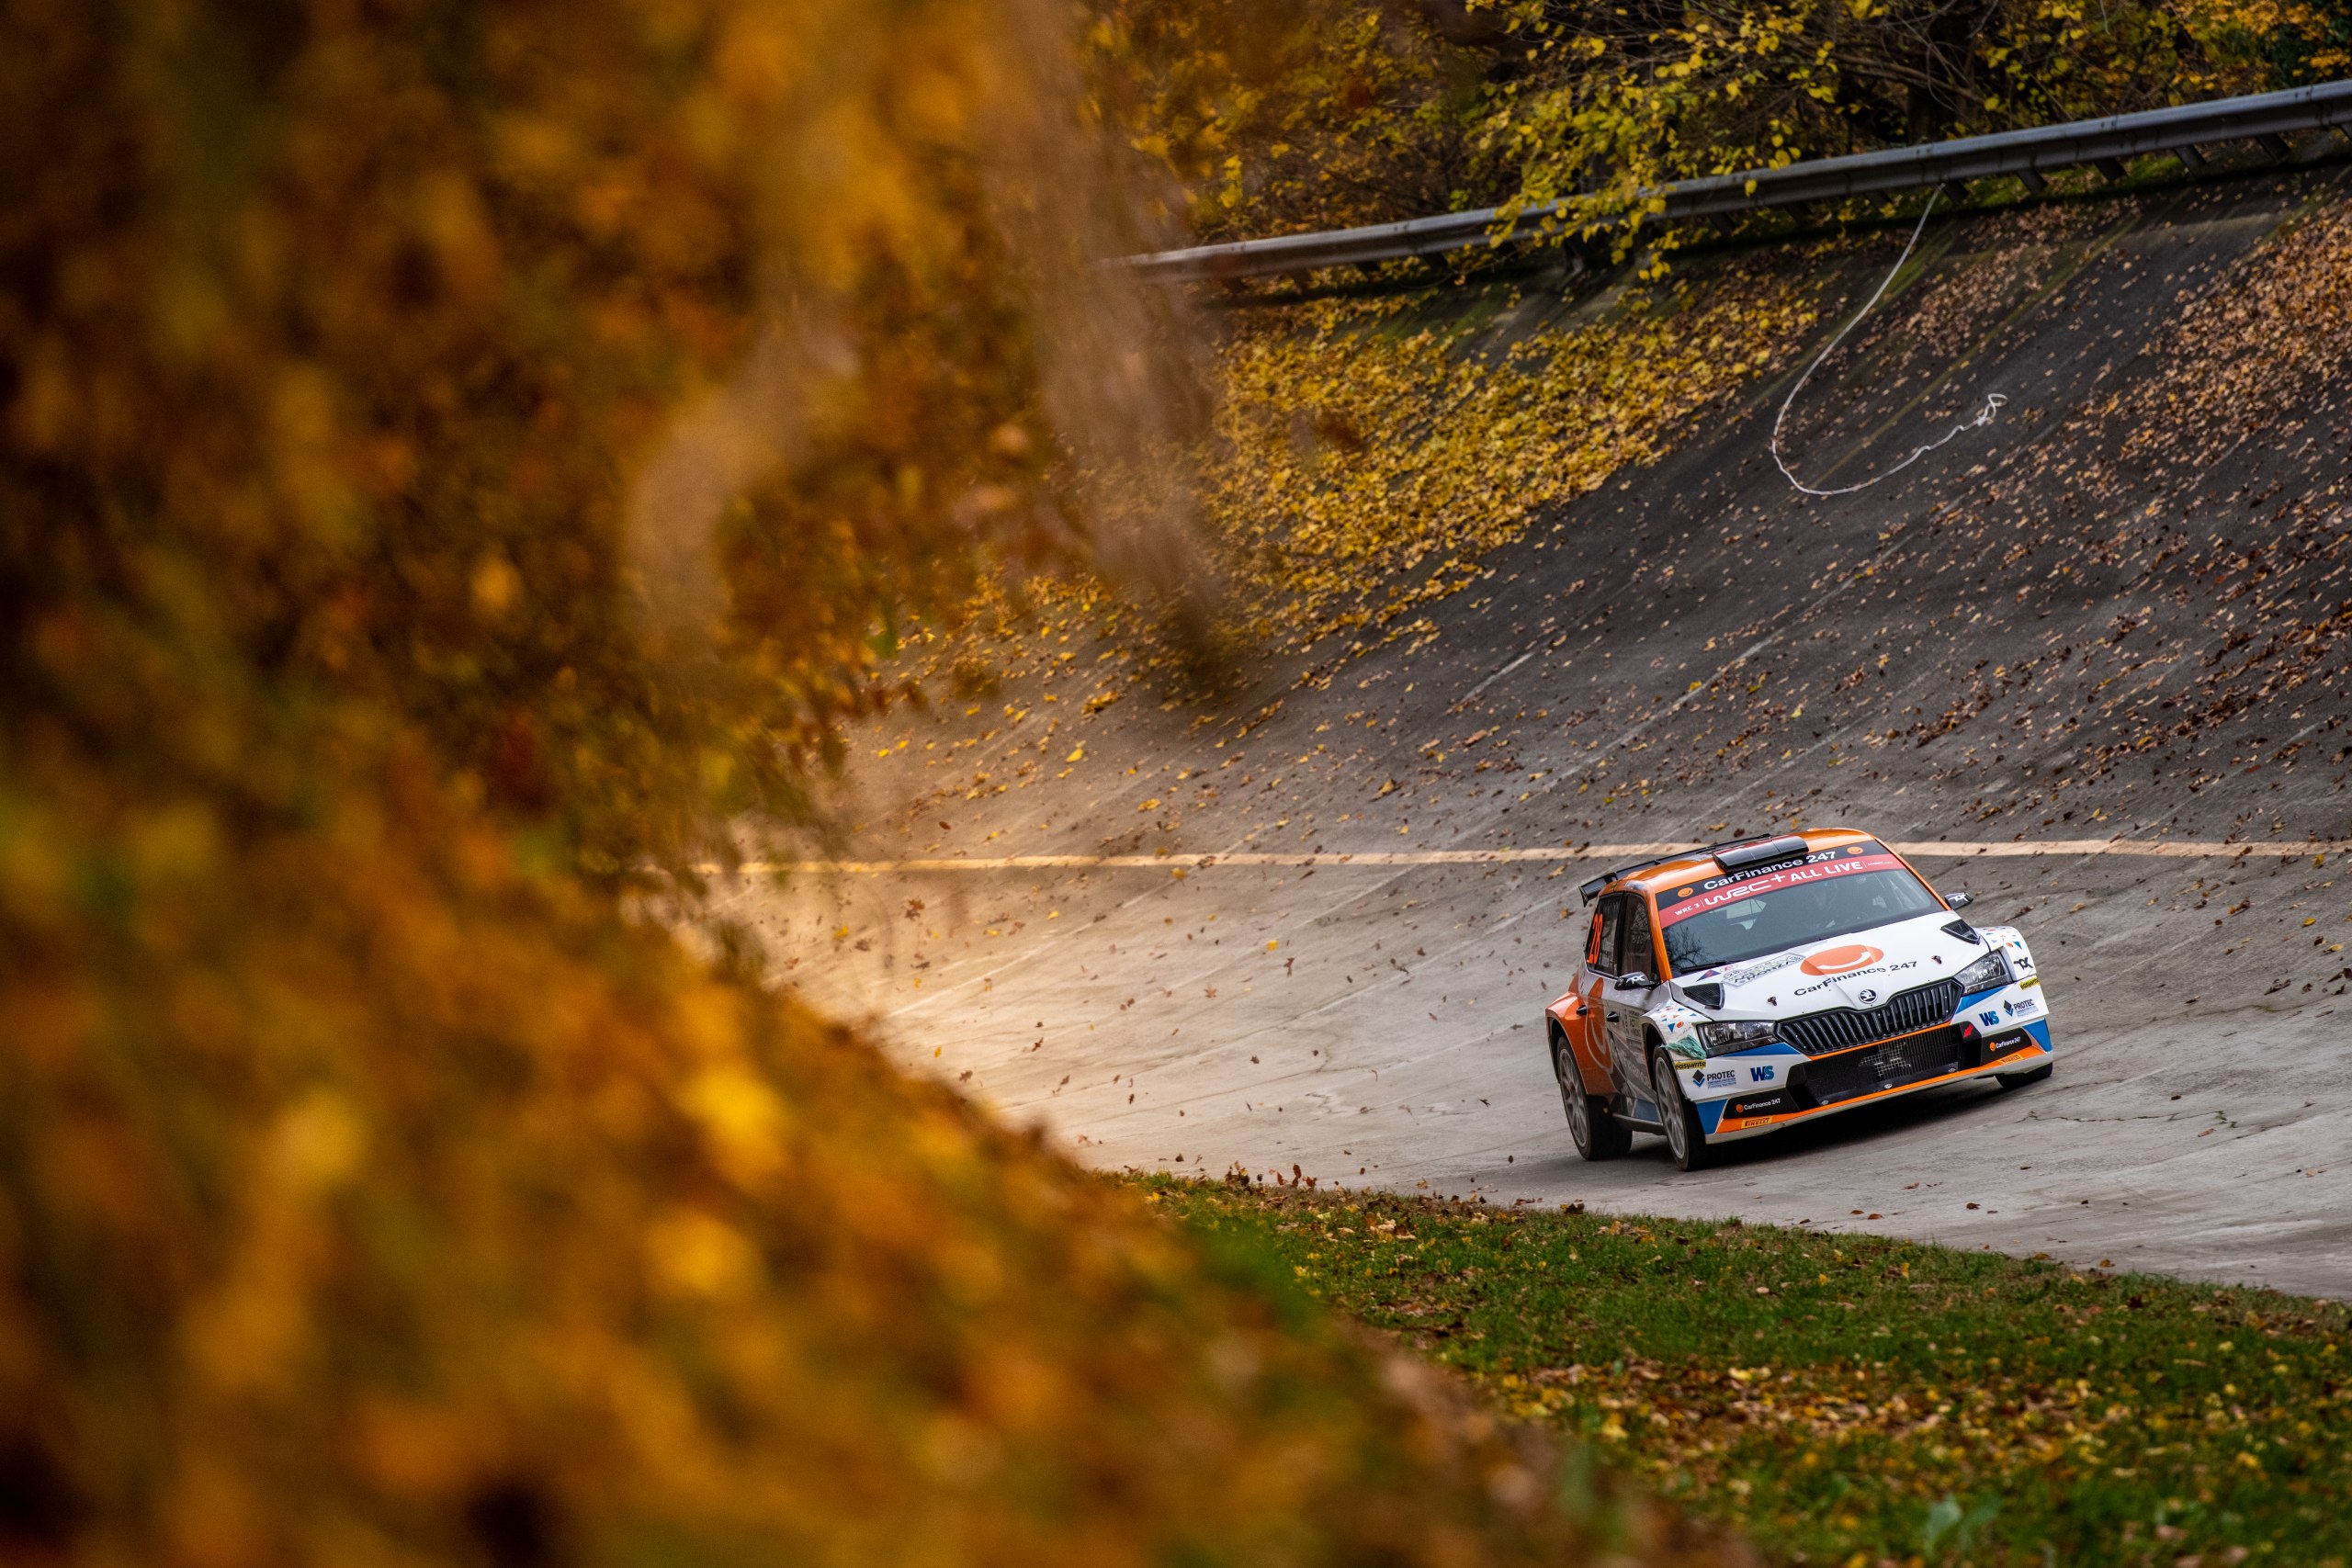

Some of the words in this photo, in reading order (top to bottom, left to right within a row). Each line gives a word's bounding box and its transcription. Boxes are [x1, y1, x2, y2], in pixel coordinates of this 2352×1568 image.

[1704, 858, 1803, 890] CarFinance
[1806, 851, 1836, 863] 247
[1791, 869, 1822, 883] ALL
[1824, 862, 1863, 874] LIVE
[1675, 905, 1693, 916] WRC
[1587, 913, 1603, 964] 28
[1794, 967, 1886, 997] CarFinance
[1889, 961, 1917, 972] 247
[2014, 999, 2034, 1010] PROTEC
[1979, 1010, 1999, 1026] WS
[1996, 1039, 2015, 1048] CarFinance
[1675, 1061, 1706, 1070] easywrite
[1707, 1070, 1735, 1081] PROTEC
[1750, 1065, 1774, 1082] WS
[1744, 1101, 1771, 1111] CarFinance
[1745, 1117, 1770, 1126] PIRELLI
